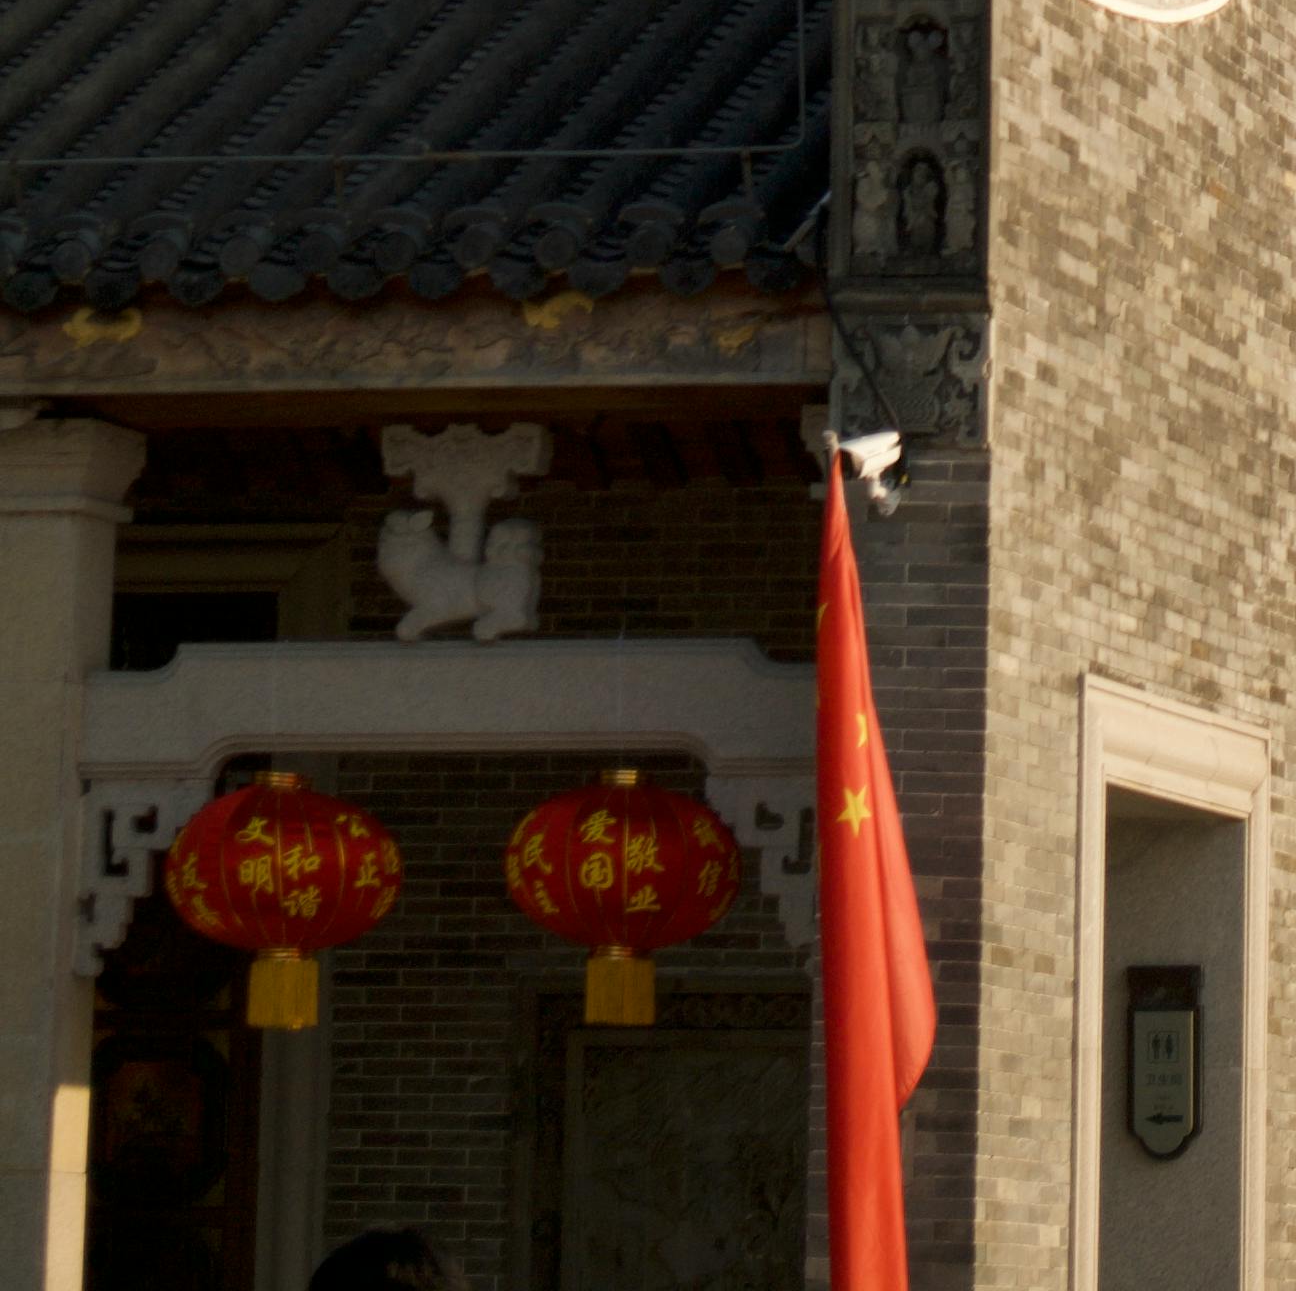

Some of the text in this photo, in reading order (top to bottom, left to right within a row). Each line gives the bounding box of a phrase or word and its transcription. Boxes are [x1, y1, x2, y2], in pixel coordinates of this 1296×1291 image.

[235, 815, 276, 894] 文明
[283, 843, 323, 919] 和谐
[335, 812, 381, 889] 公正
[578, 808, 619, 891] 爱国
[625, 833, 667, 914] 敬业
